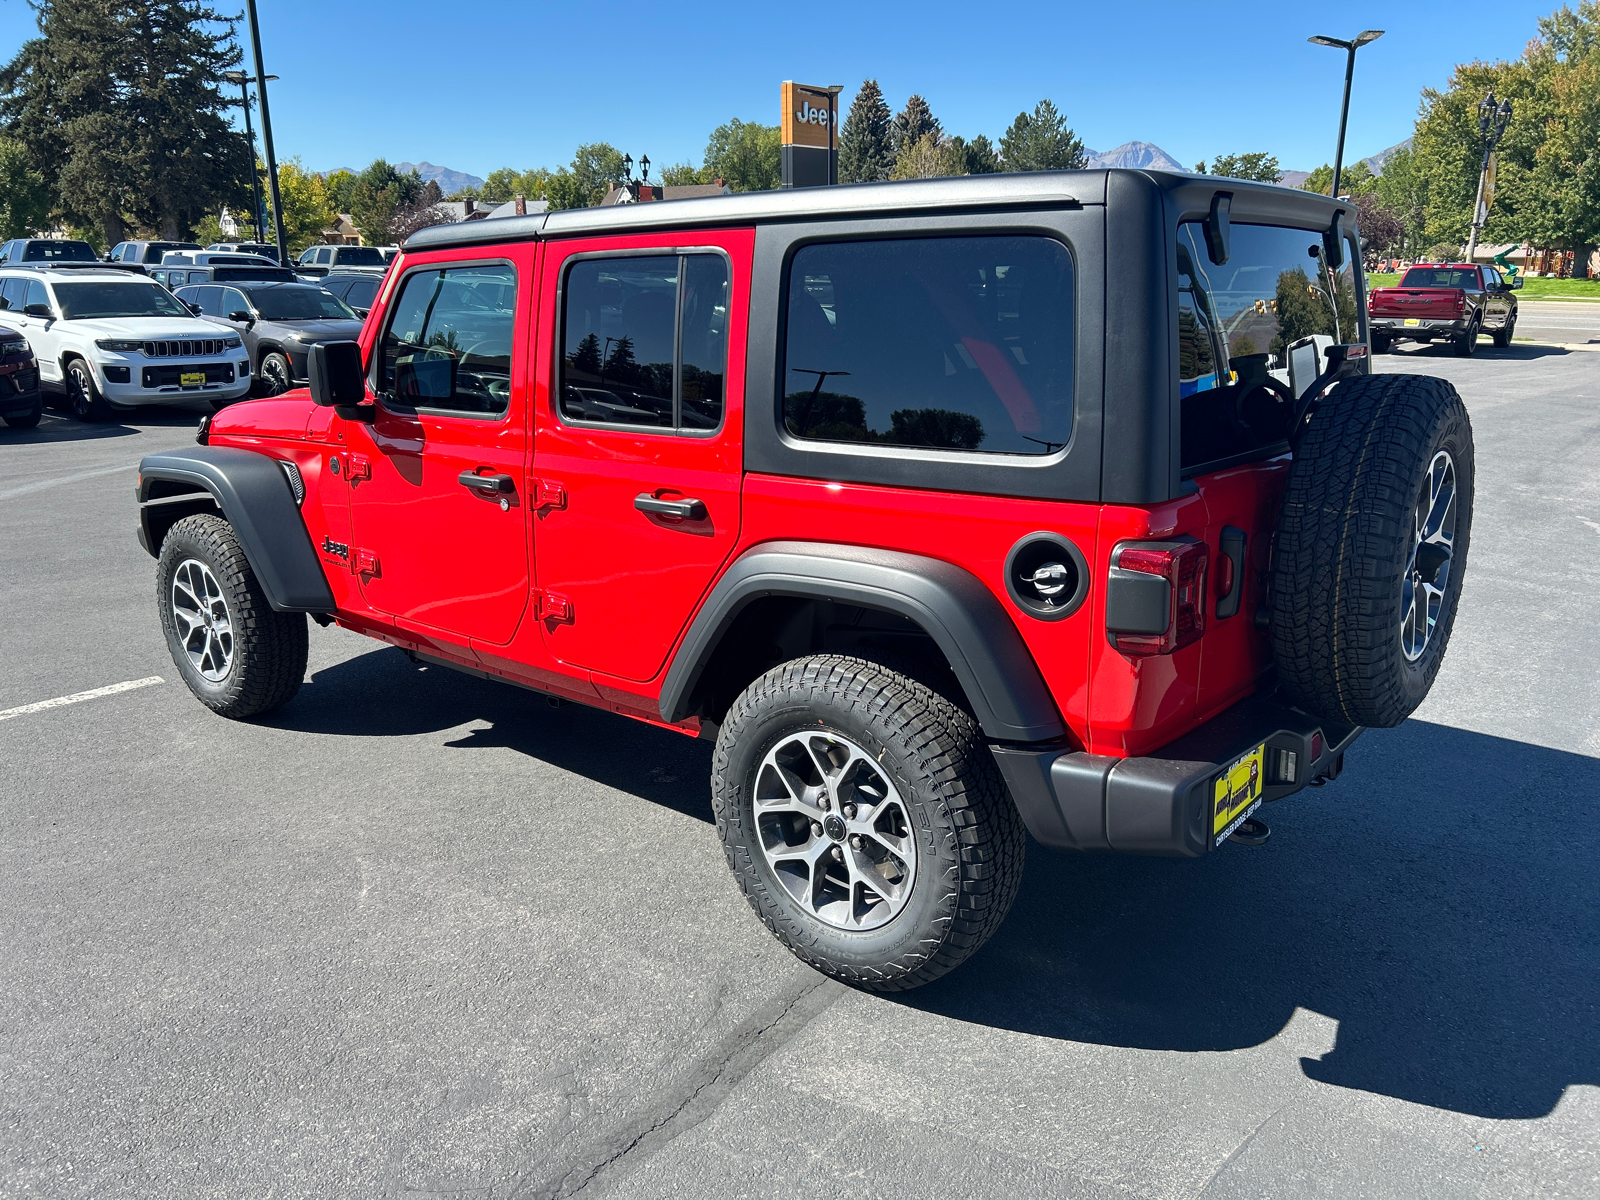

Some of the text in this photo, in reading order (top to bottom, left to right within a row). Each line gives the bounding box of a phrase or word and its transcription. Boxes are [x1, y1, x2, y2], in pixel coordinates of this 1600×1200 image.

[796, 101, 837, 131] Jeep
[321, 534, 349, 561] Jeep
[863, 729, 937, 856] NEXEN
[1216, 823, 1235, 847] CHRYSLER
[1234, 811, 1247, 830] DODGE
[1246, 804, 1255, 819] JEEP
